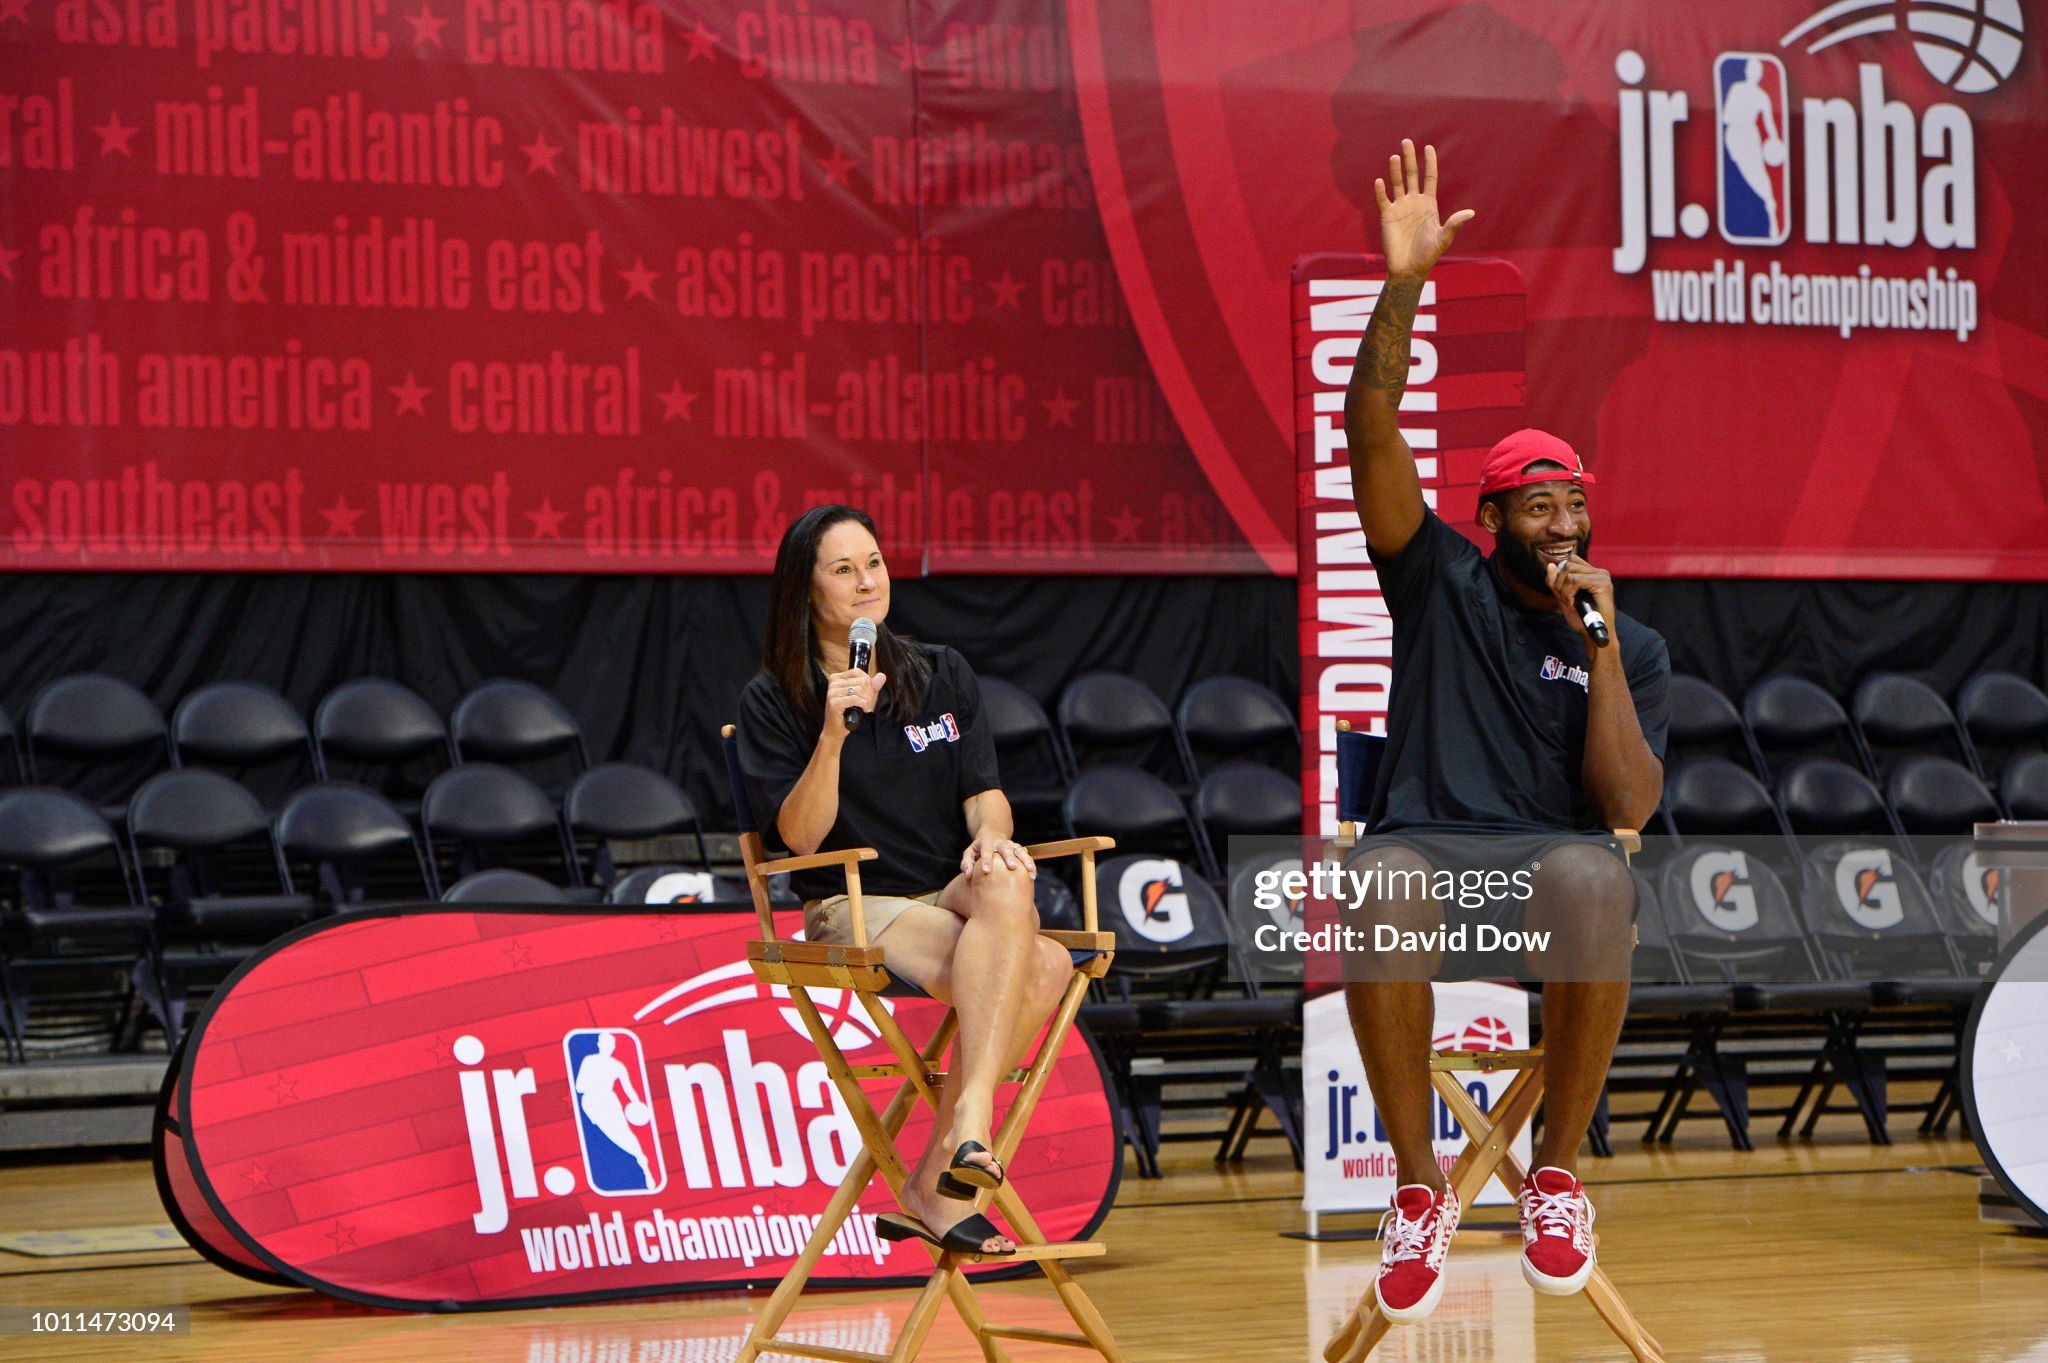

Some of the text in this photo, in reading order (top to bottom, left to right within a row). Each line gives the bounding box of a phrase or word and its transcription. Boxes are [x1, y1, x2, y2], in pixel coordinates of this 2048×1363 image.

[736, 0, 878, 85] china
[0, 77, 74, 171] ral
[155, 85, 503, 188] mid-atlantic
[578, 105, 804, 201] midwest
[1613, 50, 1976, 274] jr. nba
[40, 206, 210, 302] africa
[226, 211, 266, 303] &
[283, 216, 471, 307] middle
[487, 230, 605, 316] east
[676, 232, 787, 325] asia
[804, 236, 973, 337] pacific
[1652, 259, 1977, 342] world championship
[138, 339, 373, 430] america
[449, 347, 641, 436] central
[713, 353, 1027, 443] mid-atlantic
[12, 461, 304, 556] southeast
[379, 471, 513, 556] west
[584, 467, 737, 557] africa
[803, 472, 973, 557] ddle
[988, 480, 1098, 557] east
[1118, 859, 1195, 943] G
[453, 1029, 874, 1234] jr. nba
[1325, 1070, 1367, 1160] jr.
[1343, 1153, 1390, 1180] world
[520, 1211, 634, 1273] world
